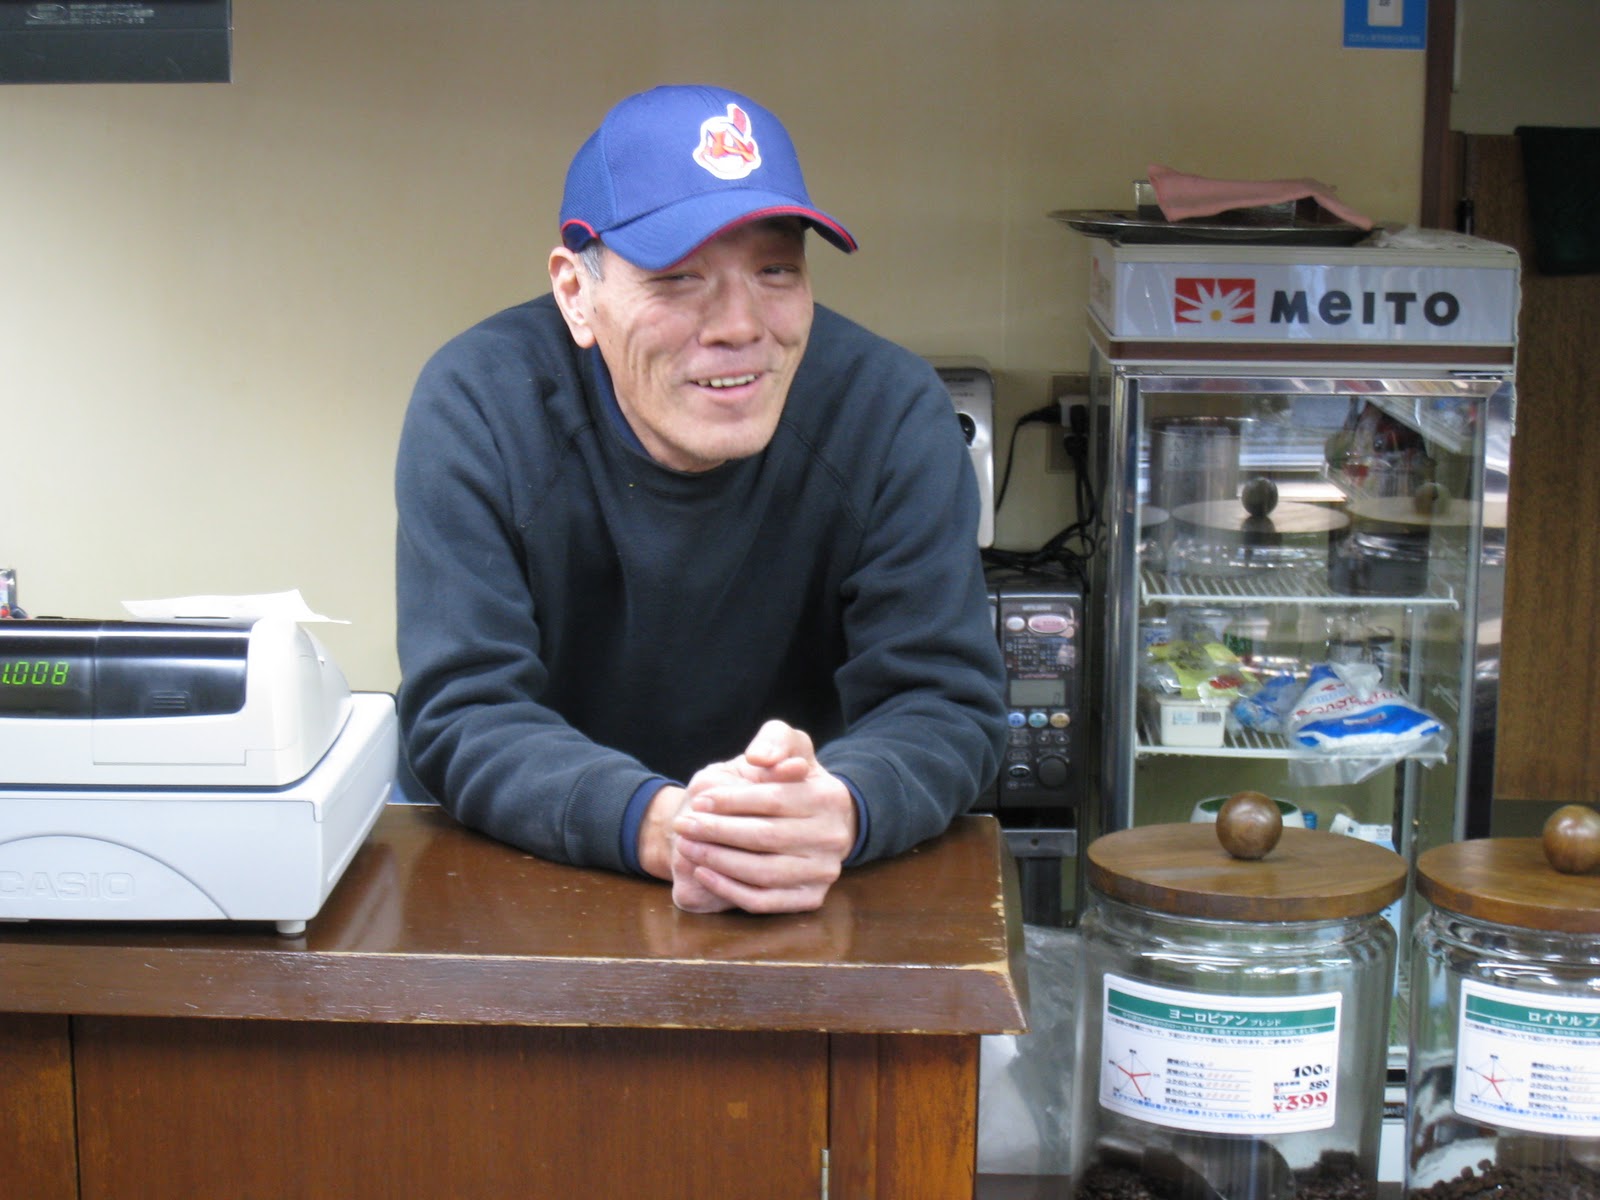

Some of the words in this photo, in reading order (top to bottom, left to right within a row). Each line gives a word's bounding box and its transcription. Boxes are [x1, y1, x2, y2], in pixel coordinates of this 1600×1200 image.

[0, 871, 135, 900] CASIO
[1169, 1009, 1248, 1026] ヨーロピアン
[1528, 1011, 1583, 1026] ロイヤル
